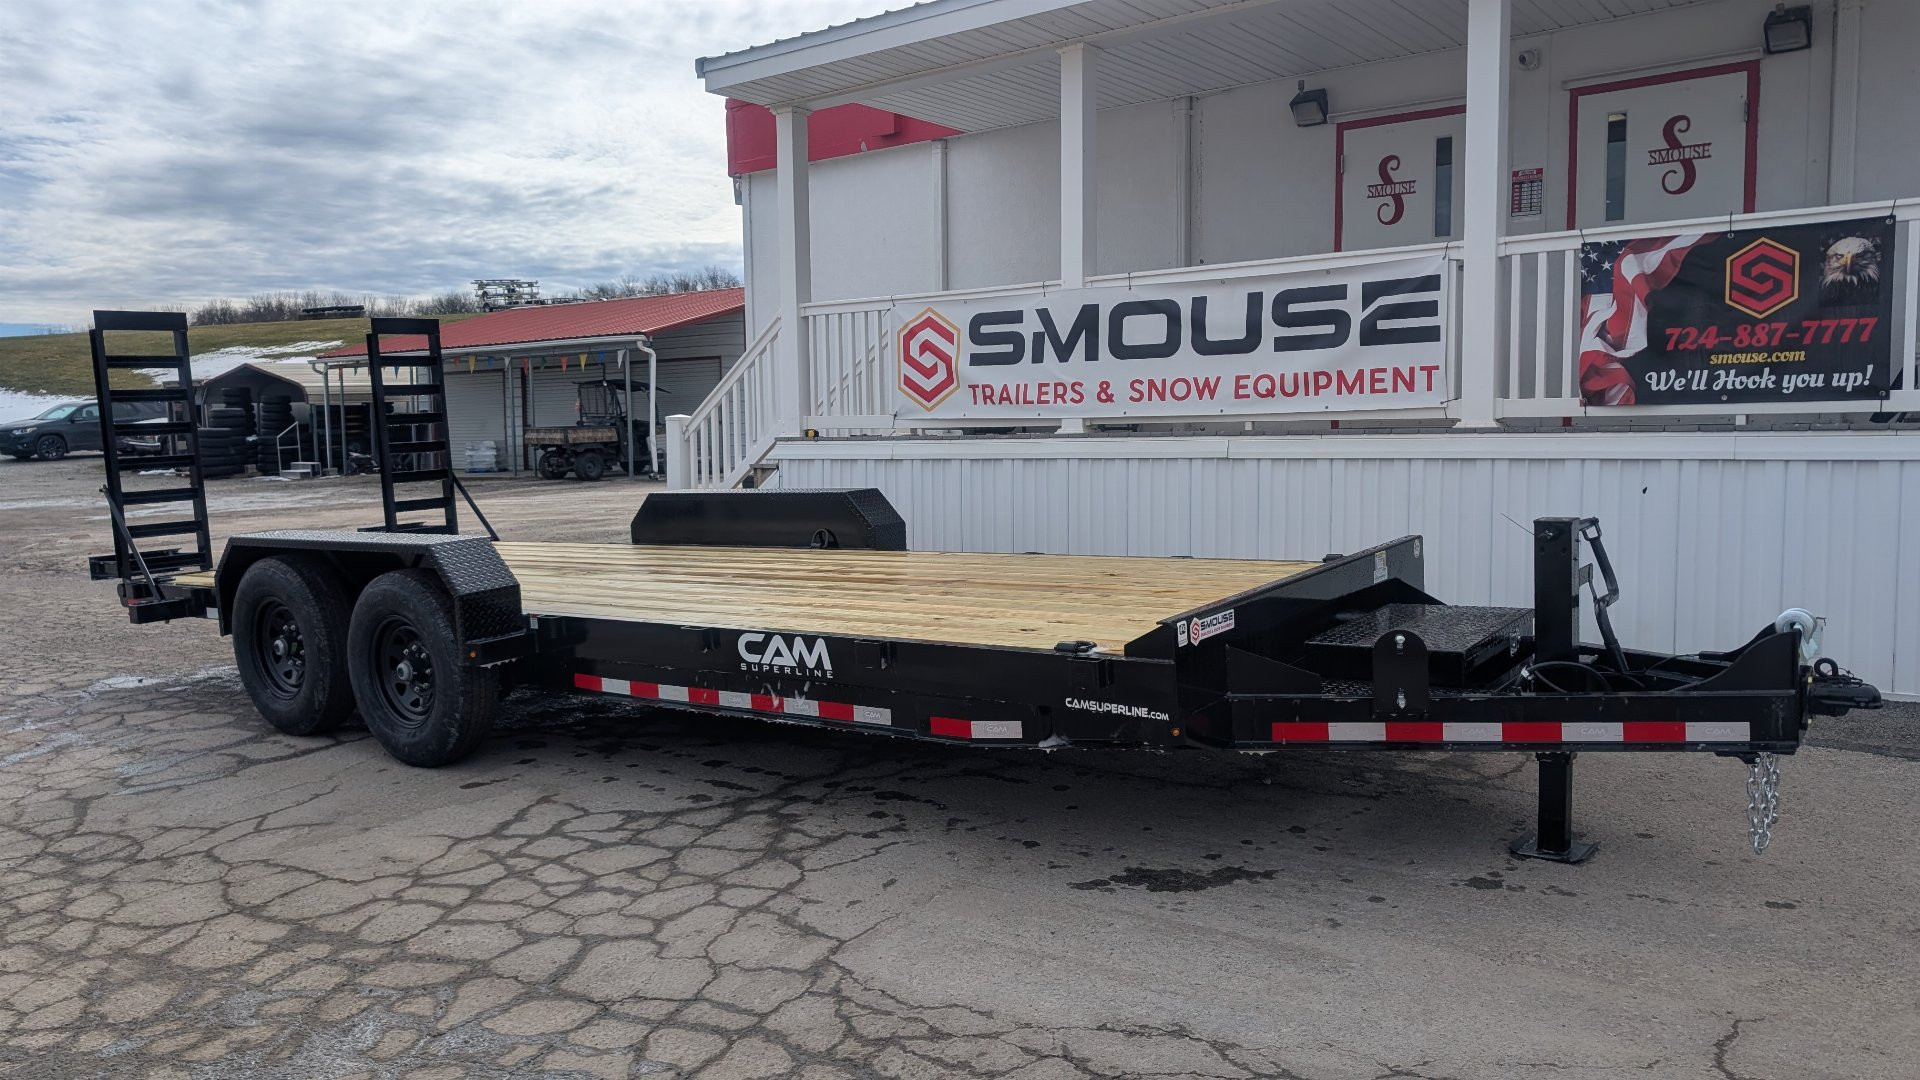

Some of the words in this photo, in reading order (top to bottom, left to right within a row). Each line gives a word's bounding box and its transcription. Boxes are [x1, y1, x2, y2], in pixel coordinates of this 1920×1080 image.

[1648, 142, 1712, 165] SMOUSE
[1367, 181, 1417, 199] SMOUSE
[968, 273, 1442, 367] SMOUSE
[1665, 316, 1879, 351] 724-887-7777
[1709, 350, 1806, 365] smouse.com
[967, 381, 1085, 407] TRAILERS
[1096, 381, 1116, 404] &
[1129, 375, 1222, 402] SNOW
[1233, 364, 1441, 400] EQUIPMENT
[1645, 369, 1708, 393] We'll
[1712, 367, 1777, 390] Hook
[1781, 369, 1826, 394] you
[1831, 364, 1874, 393] up!
[1200, 611, 1233, 631] SMOUSE
[737, 632, 832, 671] CAM
[740, 663, 833, 679] SUPERLINE
[864, 711, 881, 719] CAM
[986, 726, 1008, 734] CAM
